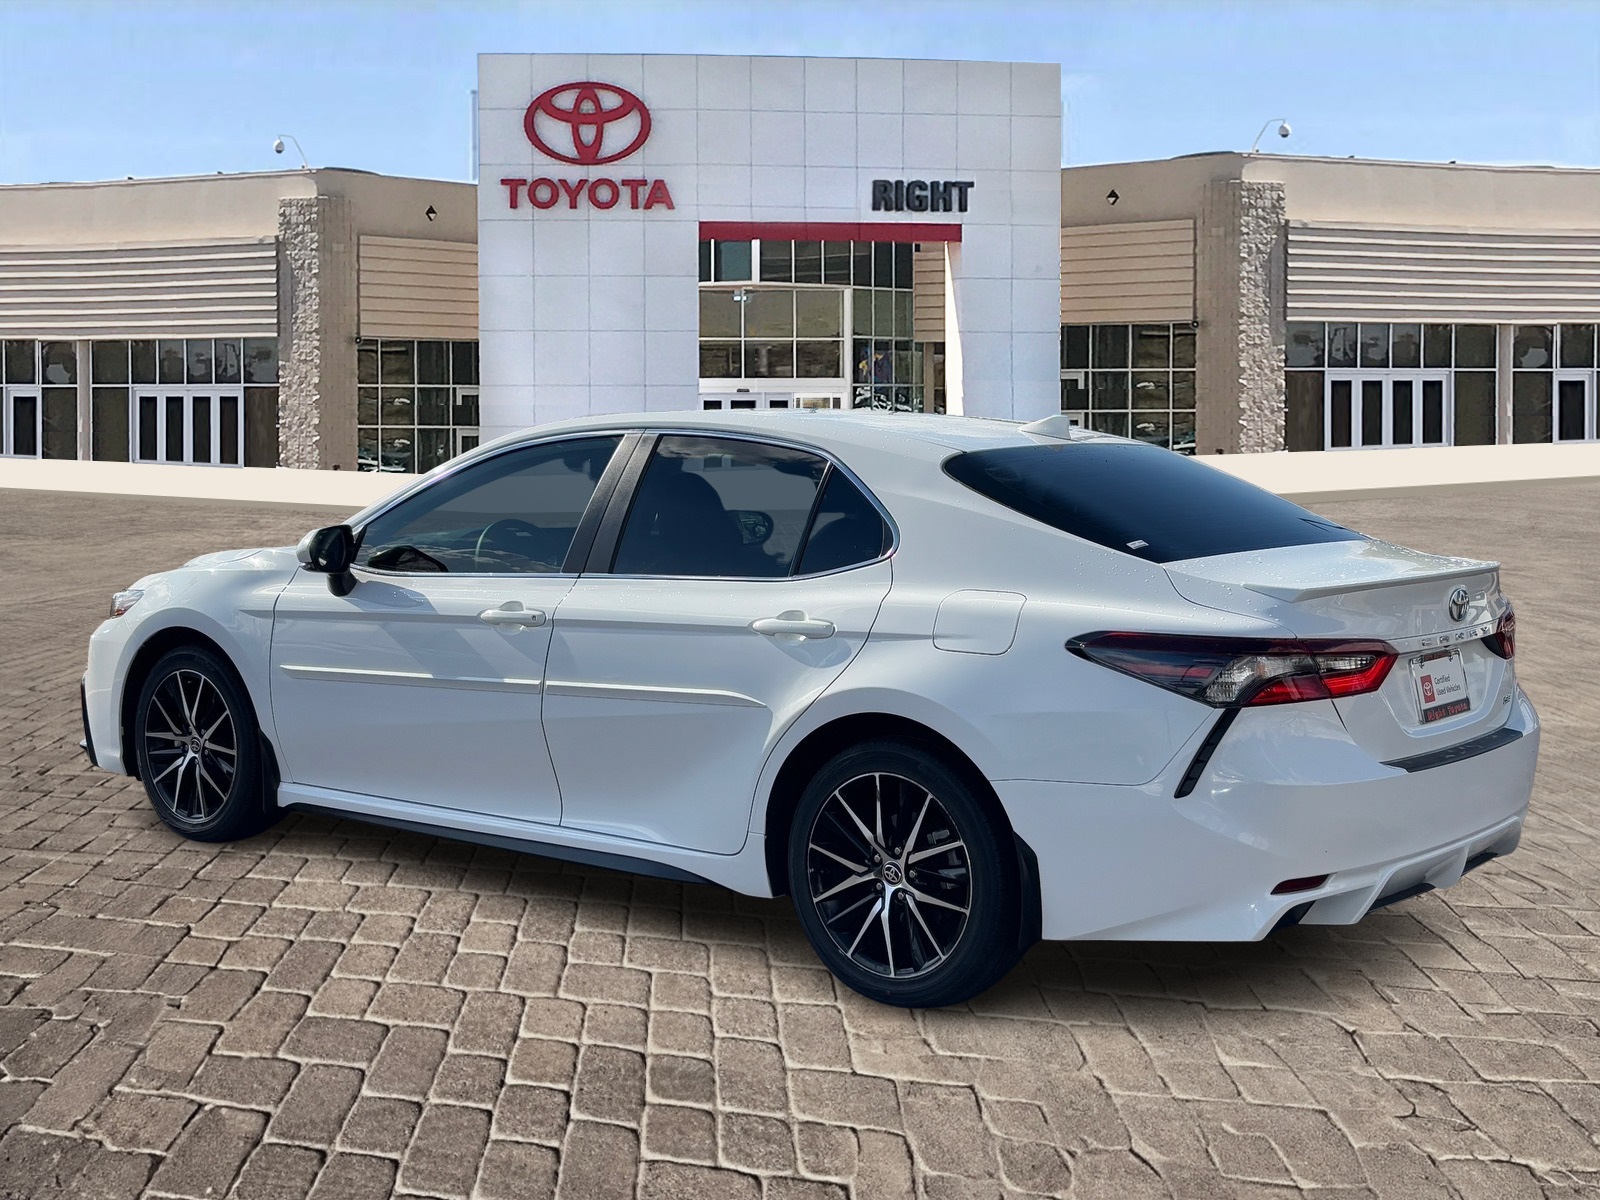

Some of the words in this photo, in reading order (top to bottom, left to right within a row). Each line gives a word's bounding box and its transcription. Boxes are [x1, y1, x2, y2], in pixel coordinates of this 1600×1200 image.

[501, 178, 675, 210] TOYOTA
[871, 179, 975, 213] RIGHT
[1434, 674, 1450, 684] Certified
[1446, 684, 1461, 693] Vehicles
